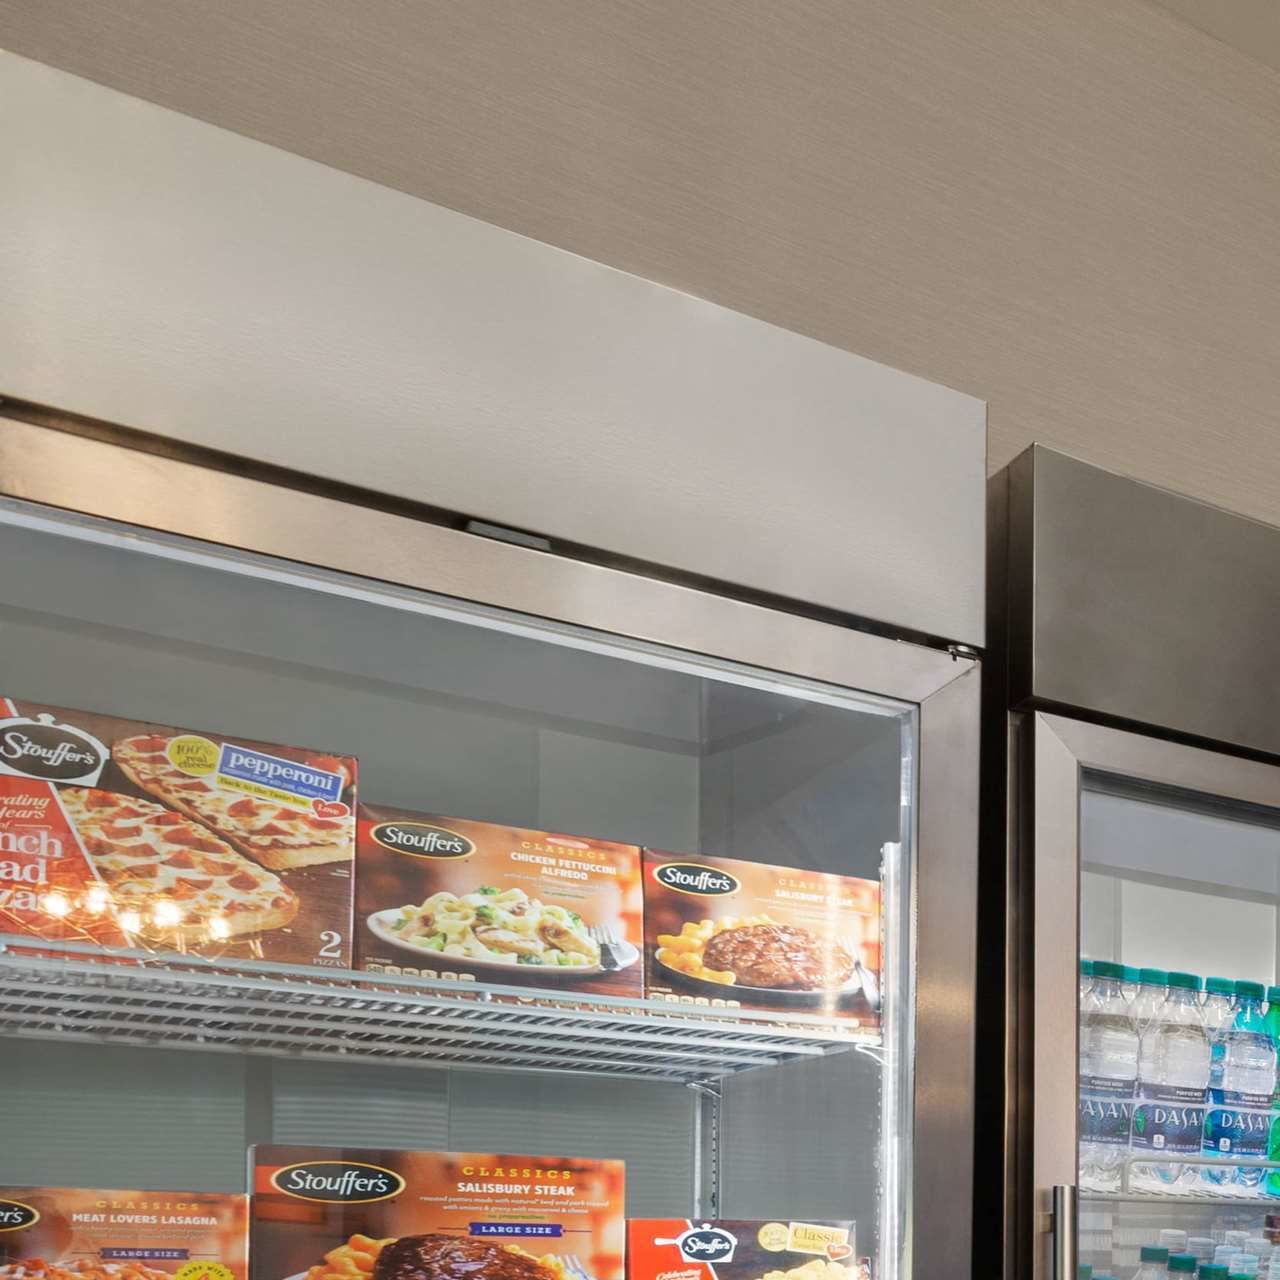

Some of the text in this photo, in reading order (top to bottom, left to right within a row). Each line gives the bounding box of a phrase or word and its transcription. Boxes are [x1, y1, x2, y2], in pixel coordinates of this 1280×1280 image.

[229, 752, 333, 790] pepperoni
[384, 827, 463, 853] Stouffer's
[511, 852, 556, 867] CHICKEN
[541, 866, 589, 881] ALFREDO
[663, 867, 731, 891] Stouffer's
[319, 931, 342, 958] 2
[462, 1166, 571, 1179] CLASSICS
[287, 1170, 389, 1197] Stouffer's
[457, 1182, 575, 1196] SALISBURY STEAK
[96, 1201, 200, 1210] CLASSICS
[72, 1213, 218, 1226] MEAT LOVERS LASAGNA
[482, 1225, 552, 1234] LARGE SIZE
[112, 1249, 180, 1258] LARGE SIZE
